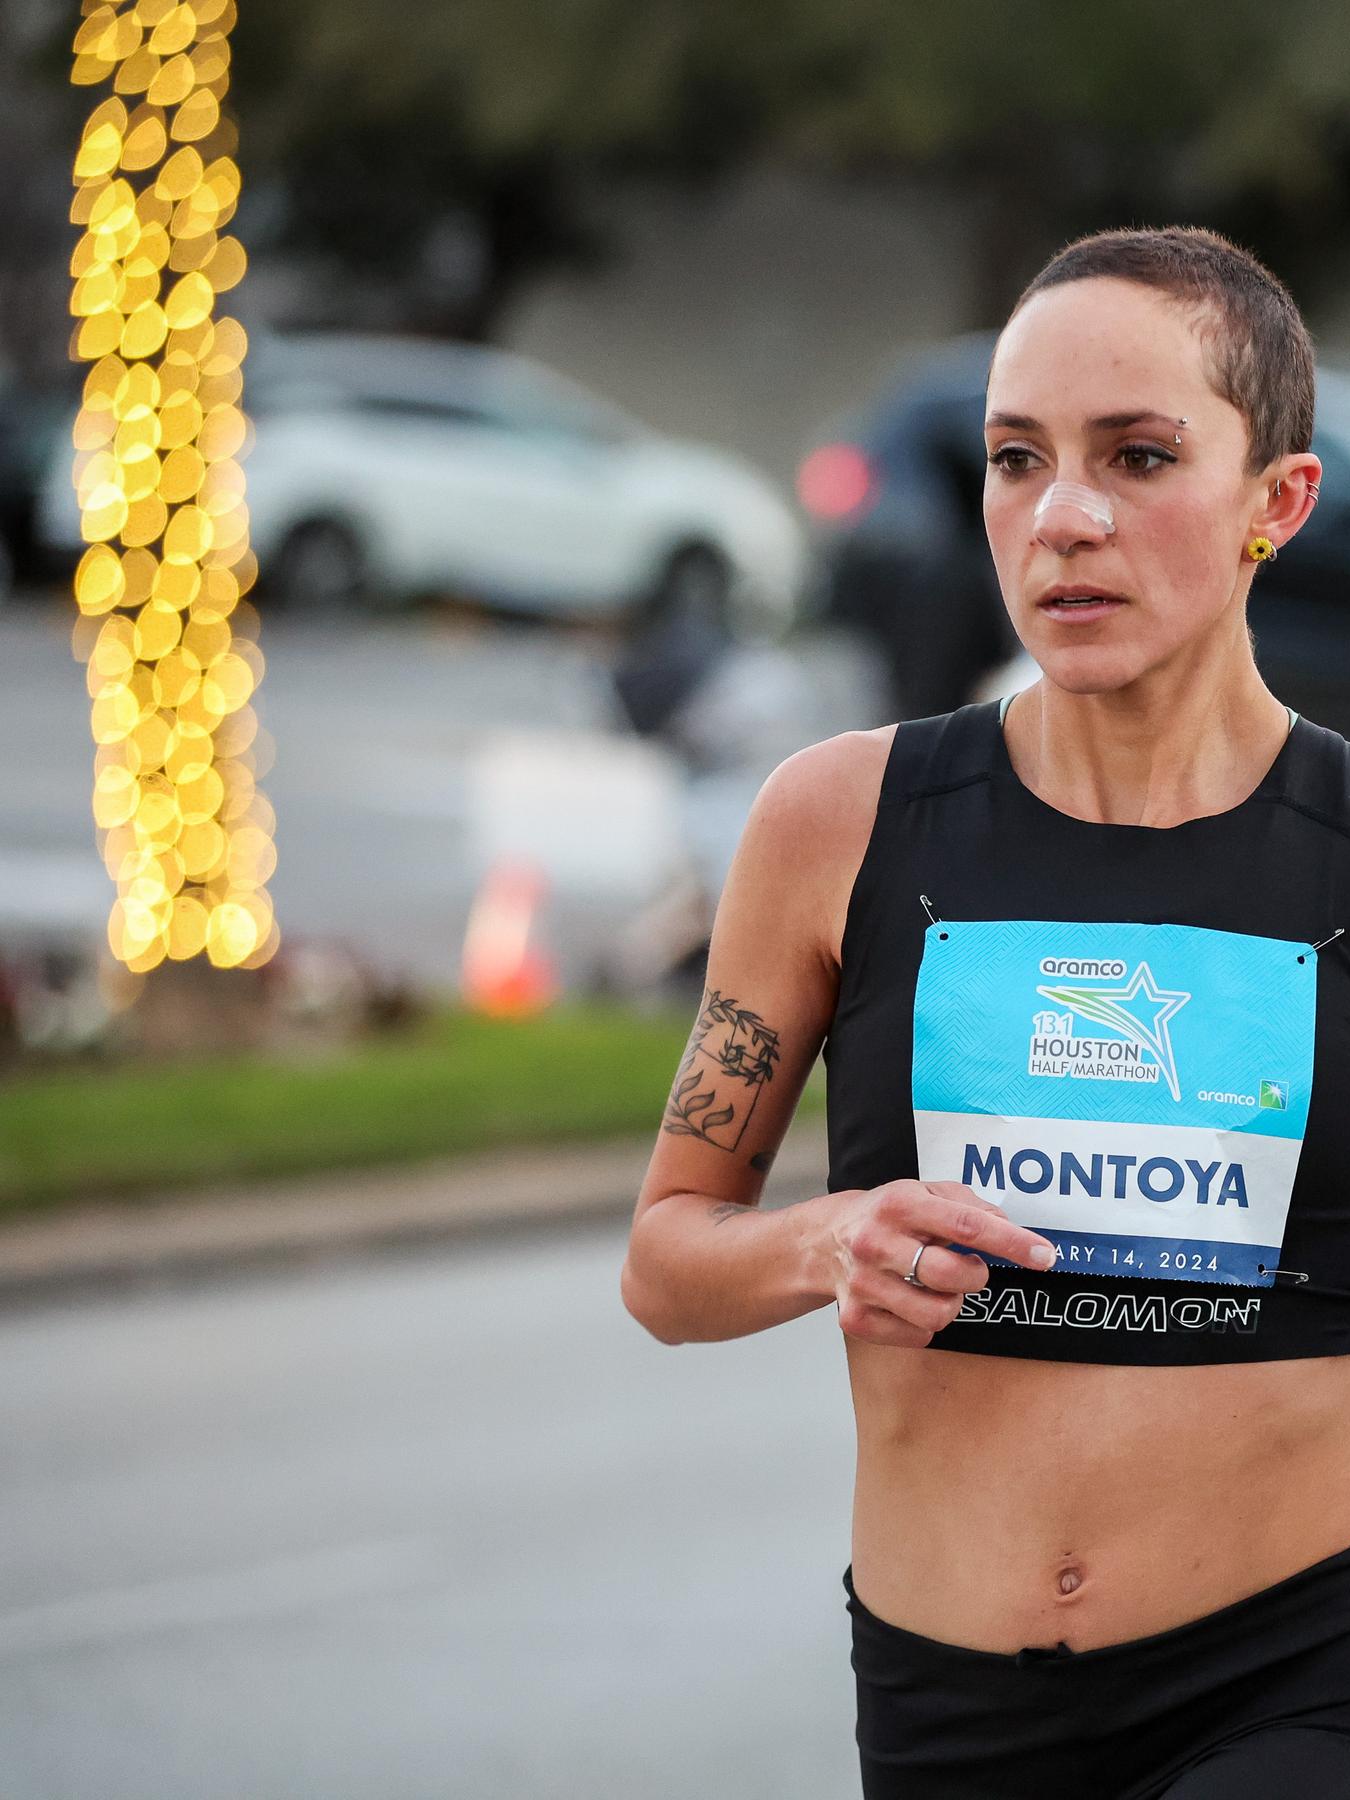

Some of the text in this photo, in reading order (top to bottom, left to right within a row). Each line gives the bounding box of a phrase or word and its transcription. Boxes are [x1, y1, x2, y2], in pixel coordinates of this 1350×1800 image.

[1042, 959, 1124, 977] aramco
[1035, 1014, 1071, 1036] 13.1
[1032, 1037, 1139, 1062] HOUSTON
[1031, 1059, 1157, 1080] HALF MARATHON
[1197, 1089, 1256, 1107] aramco
[961, 1143, 1250, 1209] MONTOYA
[1111, 1248, 1144, 1269] 14,
[1159, 1252, 1218, 1272] 2024
[953, 1287, 1261, 1334] SALOMON
